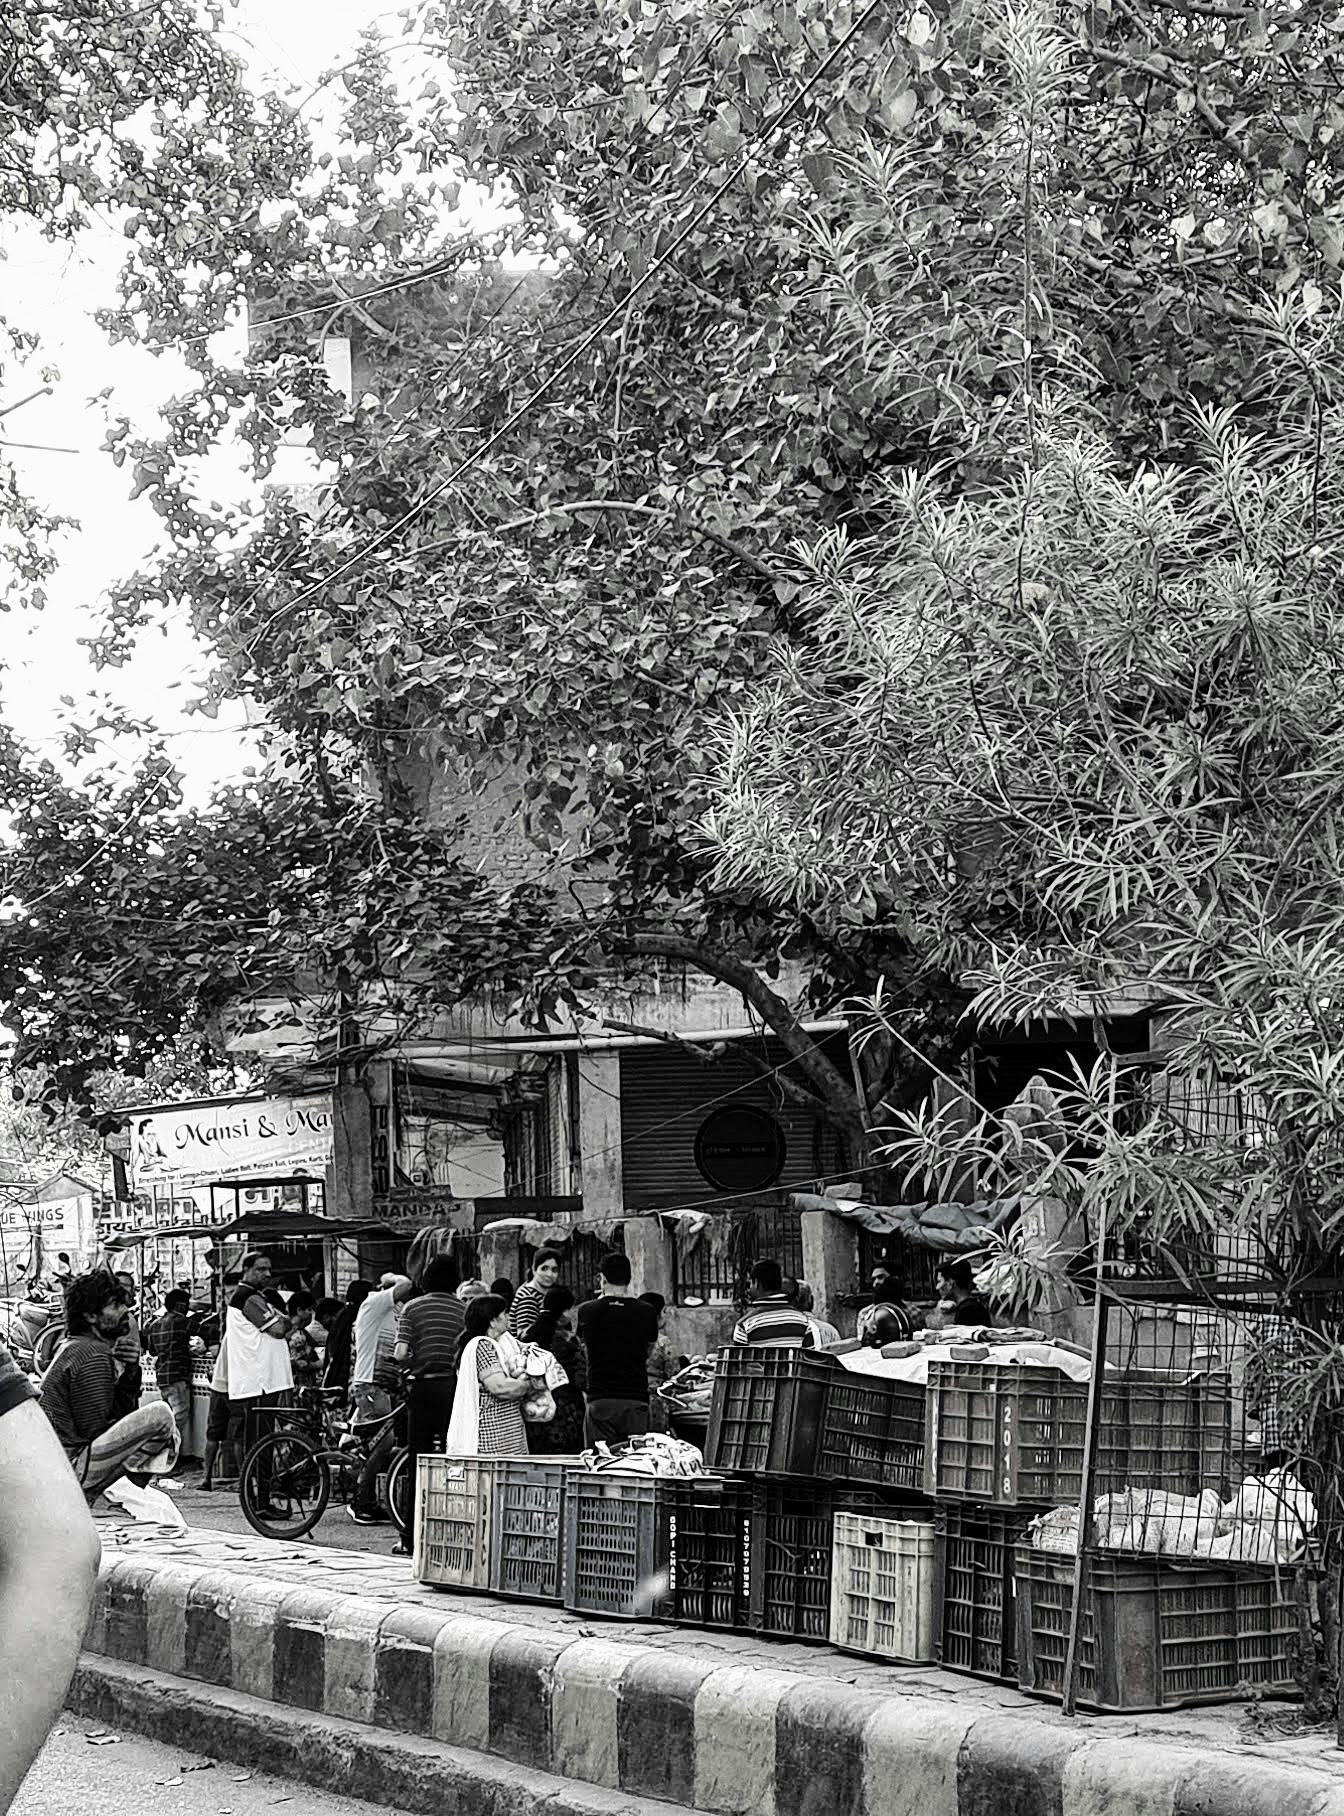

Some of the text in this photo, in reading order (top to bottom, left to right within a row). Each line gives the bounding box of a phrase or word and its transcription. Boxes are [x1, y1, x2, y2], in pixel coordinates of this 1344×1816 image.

[175, 1118, 250, 1149] Mansi
[258, 1115, 278, 1138] &
[1003, 1406, 1011, 1494] 2018
